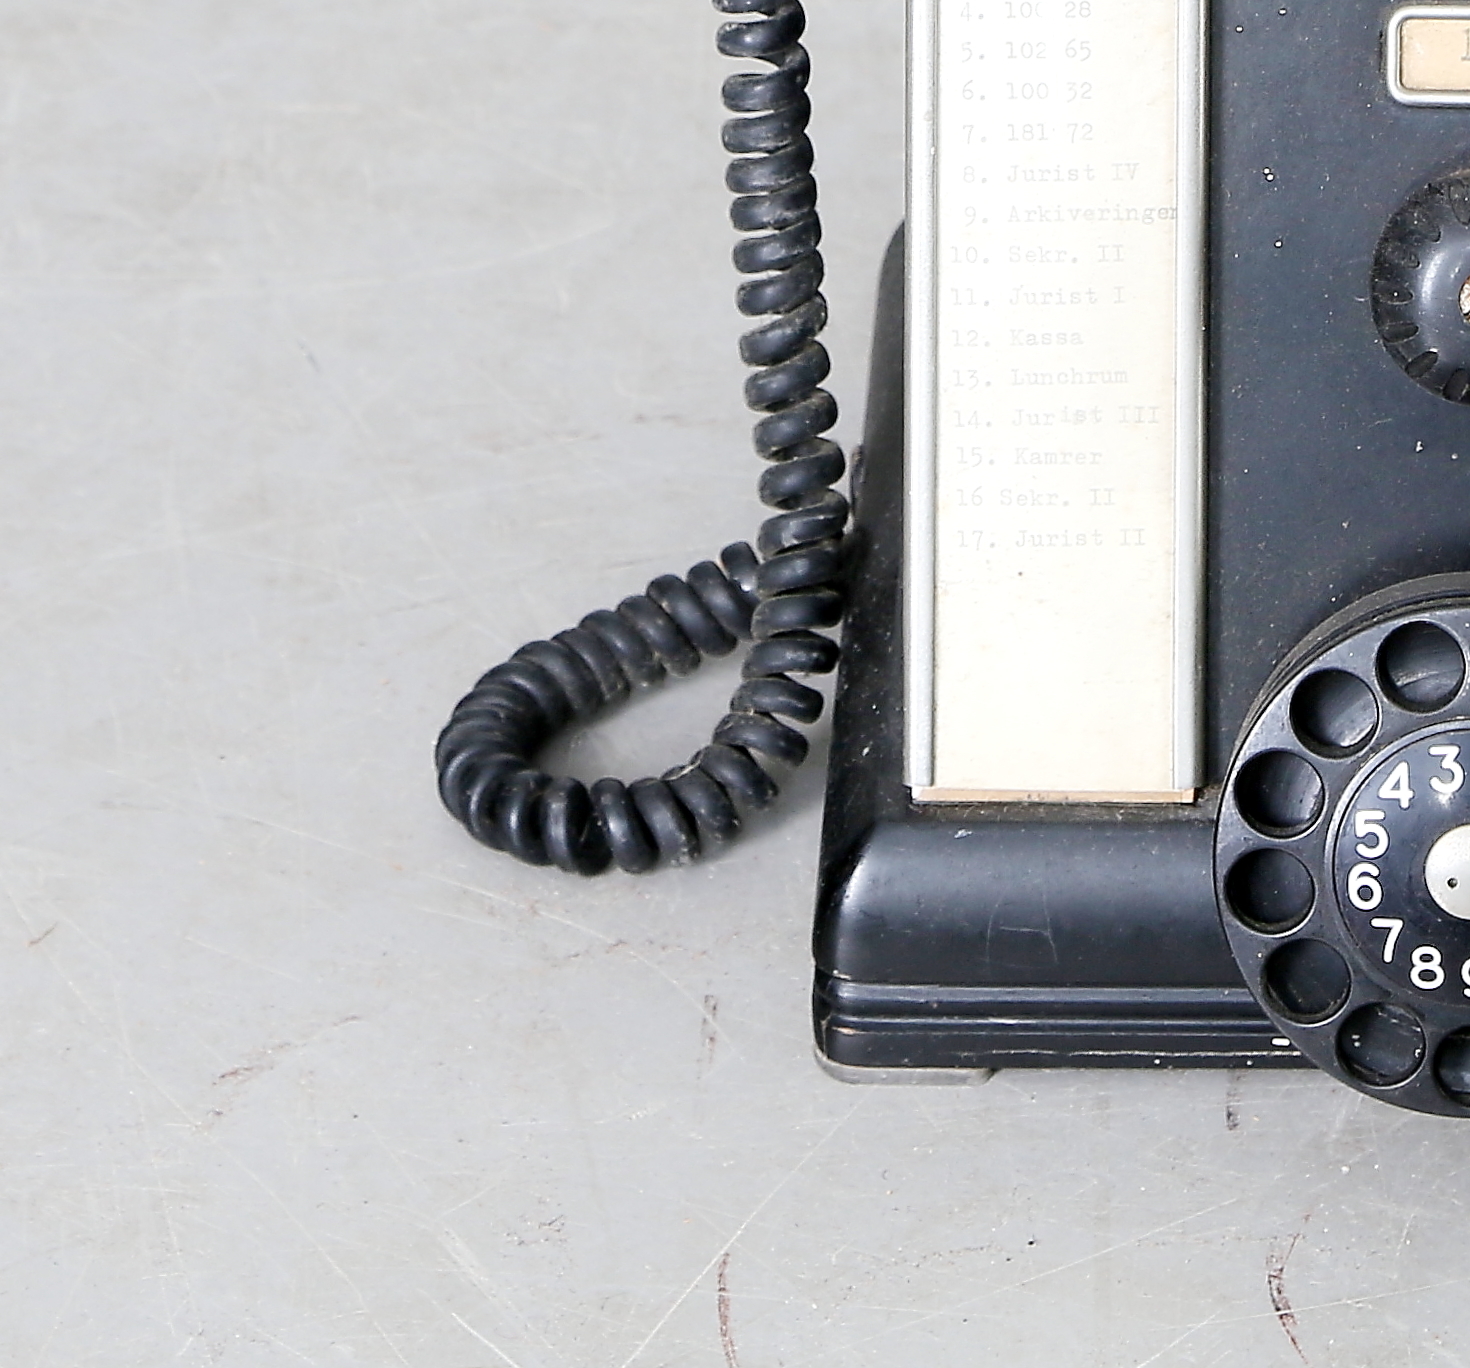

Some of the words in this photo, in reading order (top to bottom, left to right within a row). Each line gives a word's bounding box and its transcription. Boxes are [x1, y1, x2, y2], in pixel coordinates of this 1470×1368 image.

[960, 2, 984, 21] 4.
[1064, 0, 1092, 19] 28
[961, 41, 985, 62] 5.
[1065, 38, 1092, 62] 65
[962, 79, 986, 100] 6.
[1006, 82, 1049, 100] 100
[1066, 81, 1093, 103] 32
[962, 125, 987, 144] 7.
[1007, 123, 1048, 141] 181
[1067, 123, 1094, 143] 72
[963, 165, 987, 184] 8.
[1007, 164, 1095, 182] Jurist
[1111, 162, 1140, 181] IV
[964, 206, 989, 227] 9.
[950, 246, 989, 264] 10.
[1008, 245, 1078, 263] Sekr.
[1097, 244, 1124, 263] II
[950, 287, 990, 306] 11.
[1009, 287, 1098, 306] Jurist
[1113, 285, 1125, 304] I
[952, 329, 991, 347] 12.
[1009, 329, 1084, 347] Kassa
[952, 369, 992, 390] 13.
[1011, 367, 1129, 387] Lunchrum
[953, 410, 992, 429] 14.
[1011, 406, 1103, 426] Jurist
[1118, 406, 1160, 425] III
[956, 446, 995, 468] 15.
[1014, 446, 1103, 465] Kamrer
[956, 486, 983, 507] 16
[1000, 488, 1070, 507] Sekr.
[1089, 488, 1116, 506] II
[957, 530, 996, 551] 17.
[1015, 529, 1103, 548] Jurist
[1119, 528, 1146, 546] II
[1427, 744, 1466, 795] 3
[1377, 760, 1415, 809] 4
[1354, 809, 1389, 860] 5
[1347, 861, 1383, 911] 6
[1370, 917, 1403, 963] 7
[1409, 944, 1446, 990] 8
